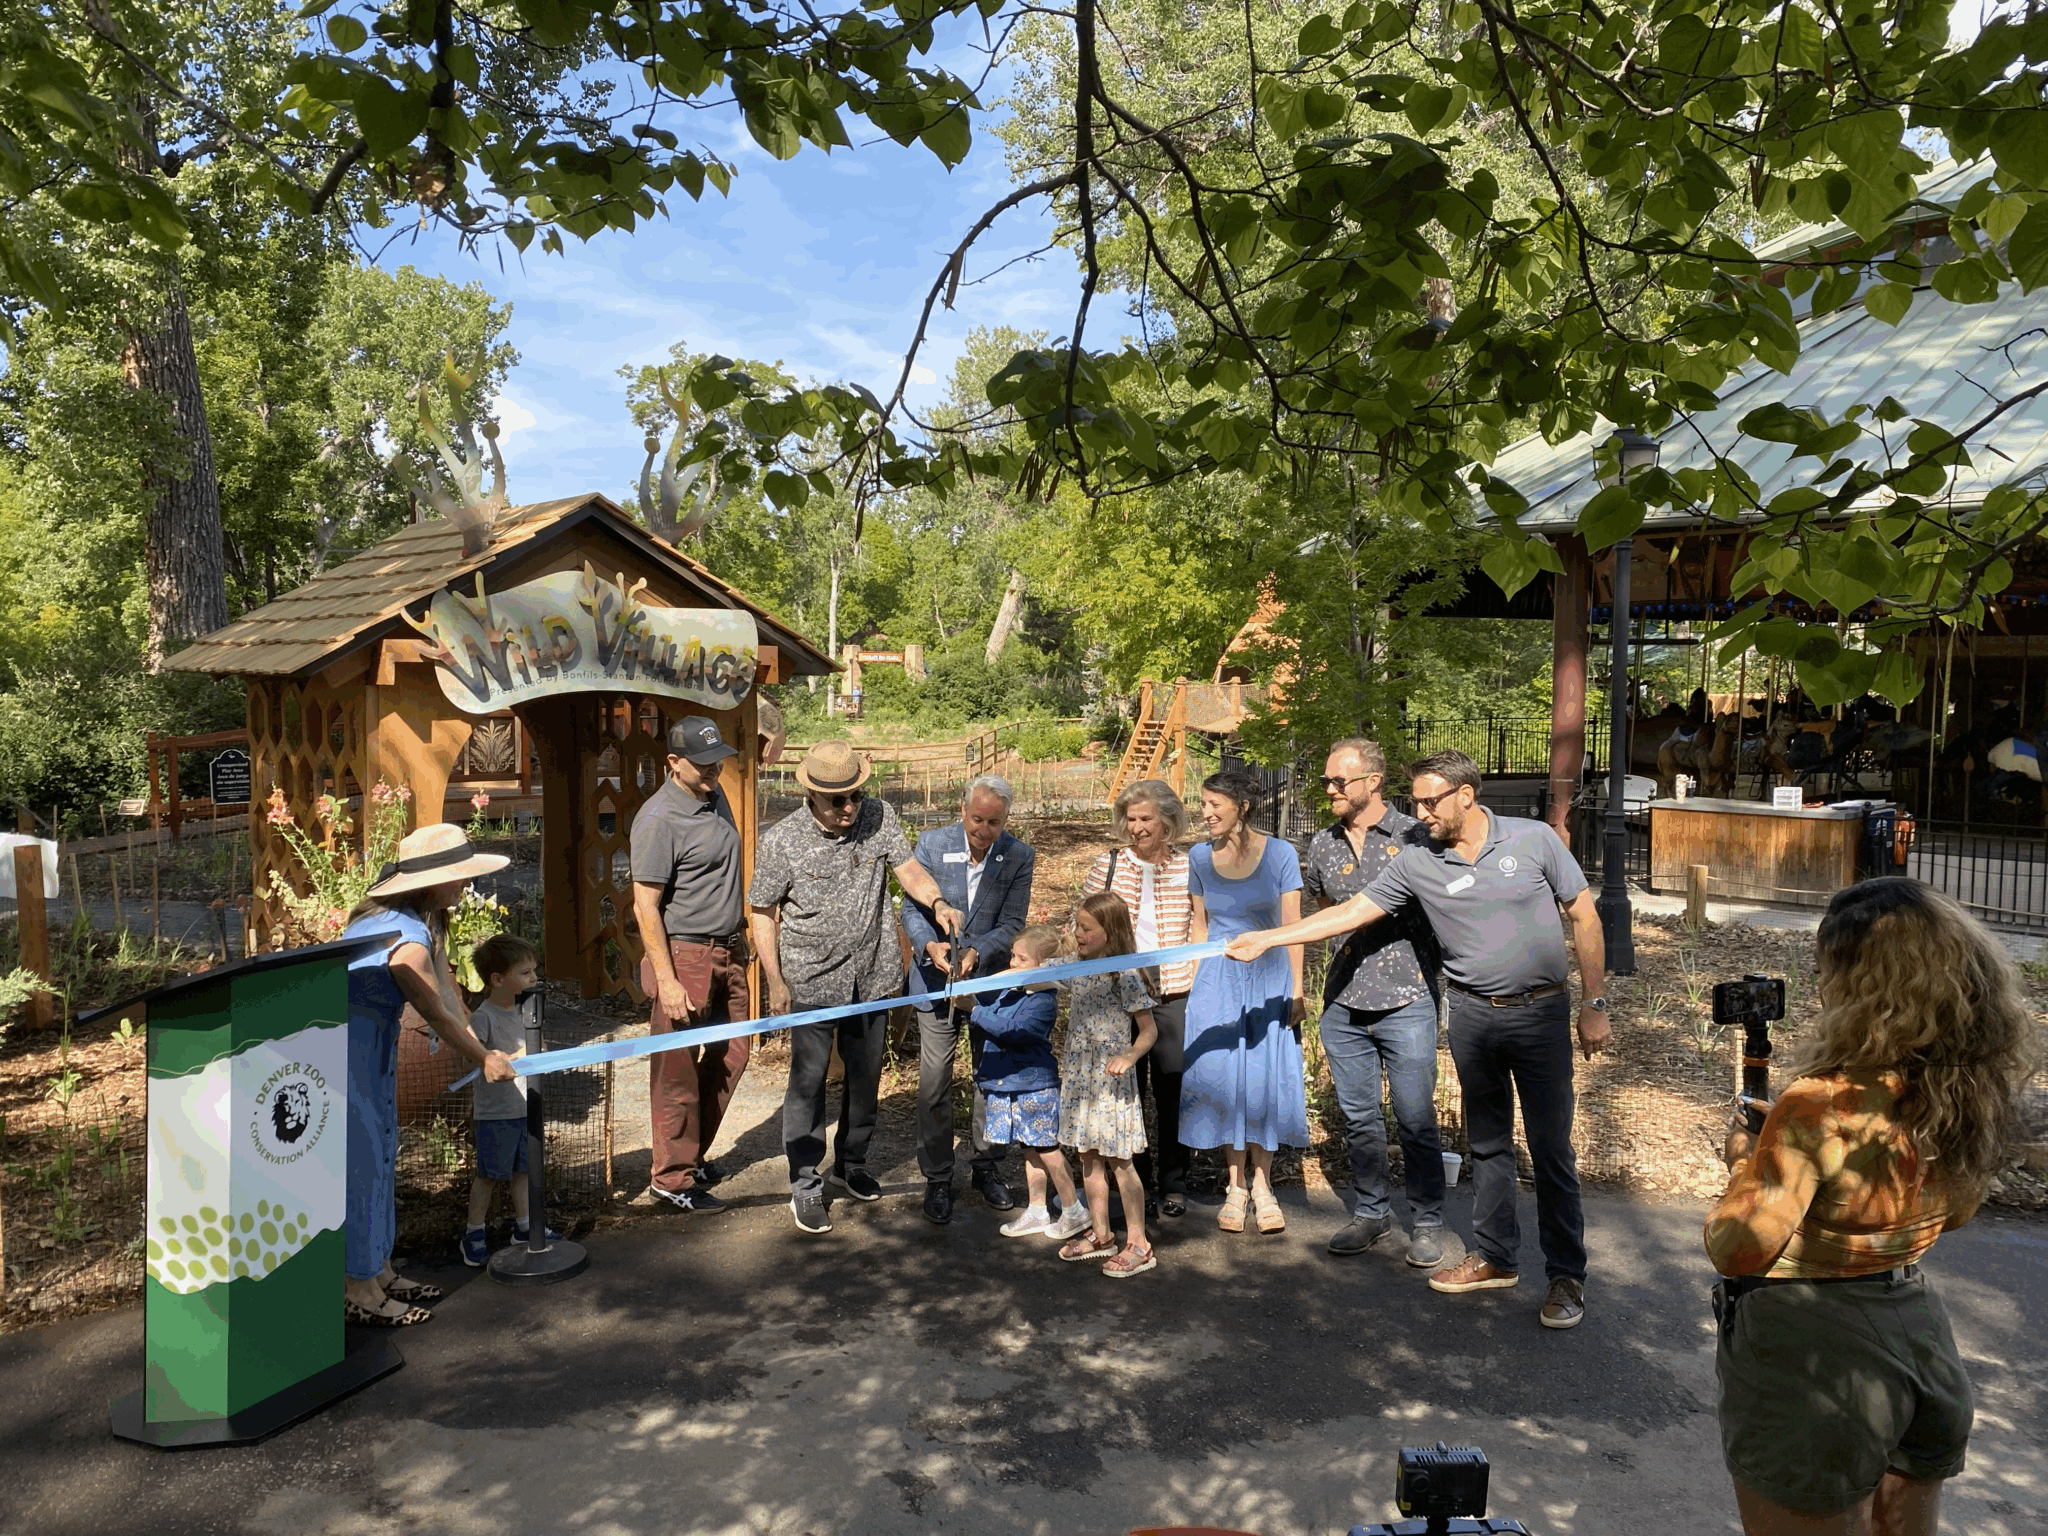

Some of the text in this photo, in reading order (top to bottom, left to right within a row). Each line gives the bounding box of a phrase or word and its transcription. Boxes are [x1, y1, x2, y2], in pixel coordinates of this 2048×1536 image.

[489, 676, 542, 696] Presented
[546, 673, 558, 684] by
[645, 674, 699, 690] Foundation
[255, 1062, 326, 1106] DENVER ZOO
[250, 1100, 331, 1166] CONSERVATION ALLIANCE
